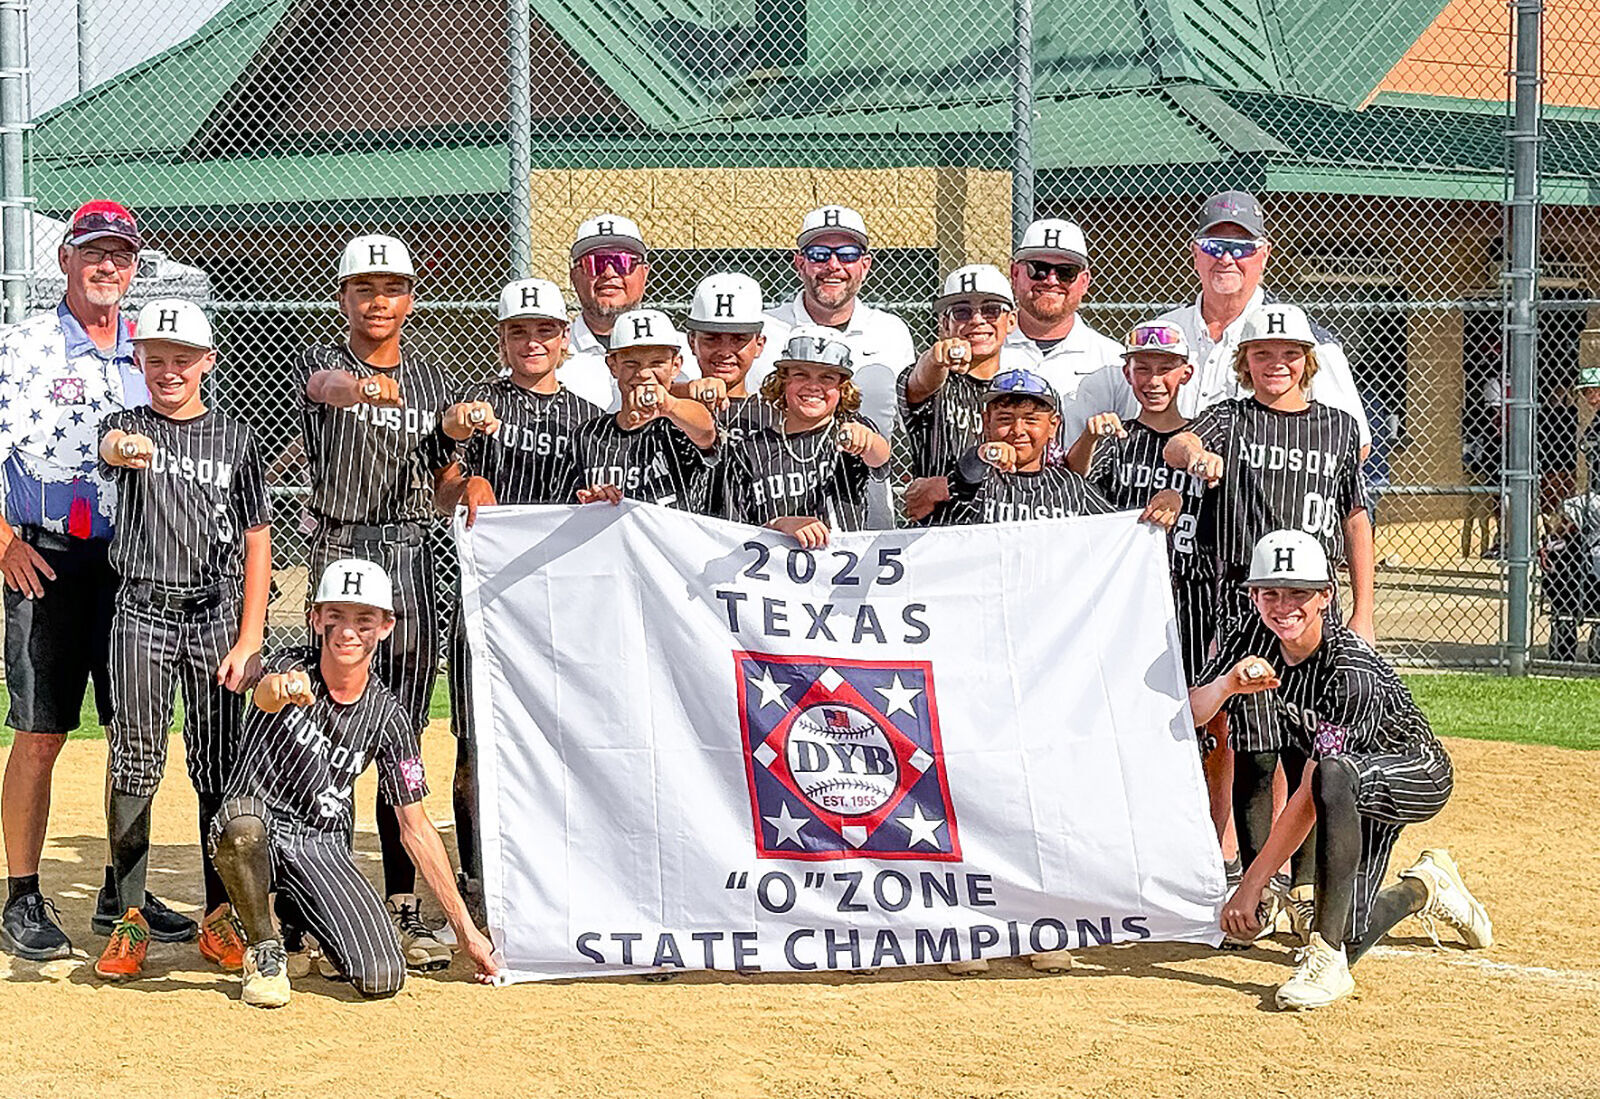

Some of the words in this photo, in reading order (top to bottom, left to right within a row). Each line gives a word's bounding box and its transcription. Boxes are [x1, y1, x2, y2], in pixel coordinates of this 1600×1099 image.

[597, 221, 614, 236] H
[823, 210, 841, 227] H
[1044, 228, 1061, 249] H
[368, 245, 388, 266] H
[960, 272, 978, 293] H
[520, 287, 541, 308] H
[714, 293, 735, 317] H
[156, 309, 179, 333] H
[632, 317, 653, 339] H
[1267, 313, 1287, 334] H
[1121, 463, 1204, 498] UDSON
[1303, 492, 1337, 538] 00
[742, 541, 905, 586] 2025
[1273, 547, 1295, 572] H
[341, 571, 364, 596] H
[715, 589, 932, 645] TEXAS
[791, 739, 896, 776] DYB
[823, 795, 849, 807] EST.
[852, 796, 878, 807] 1955
[576, 931, 763, 972] STATE
[784, 917, 1151, 971] CHAMPIONS
